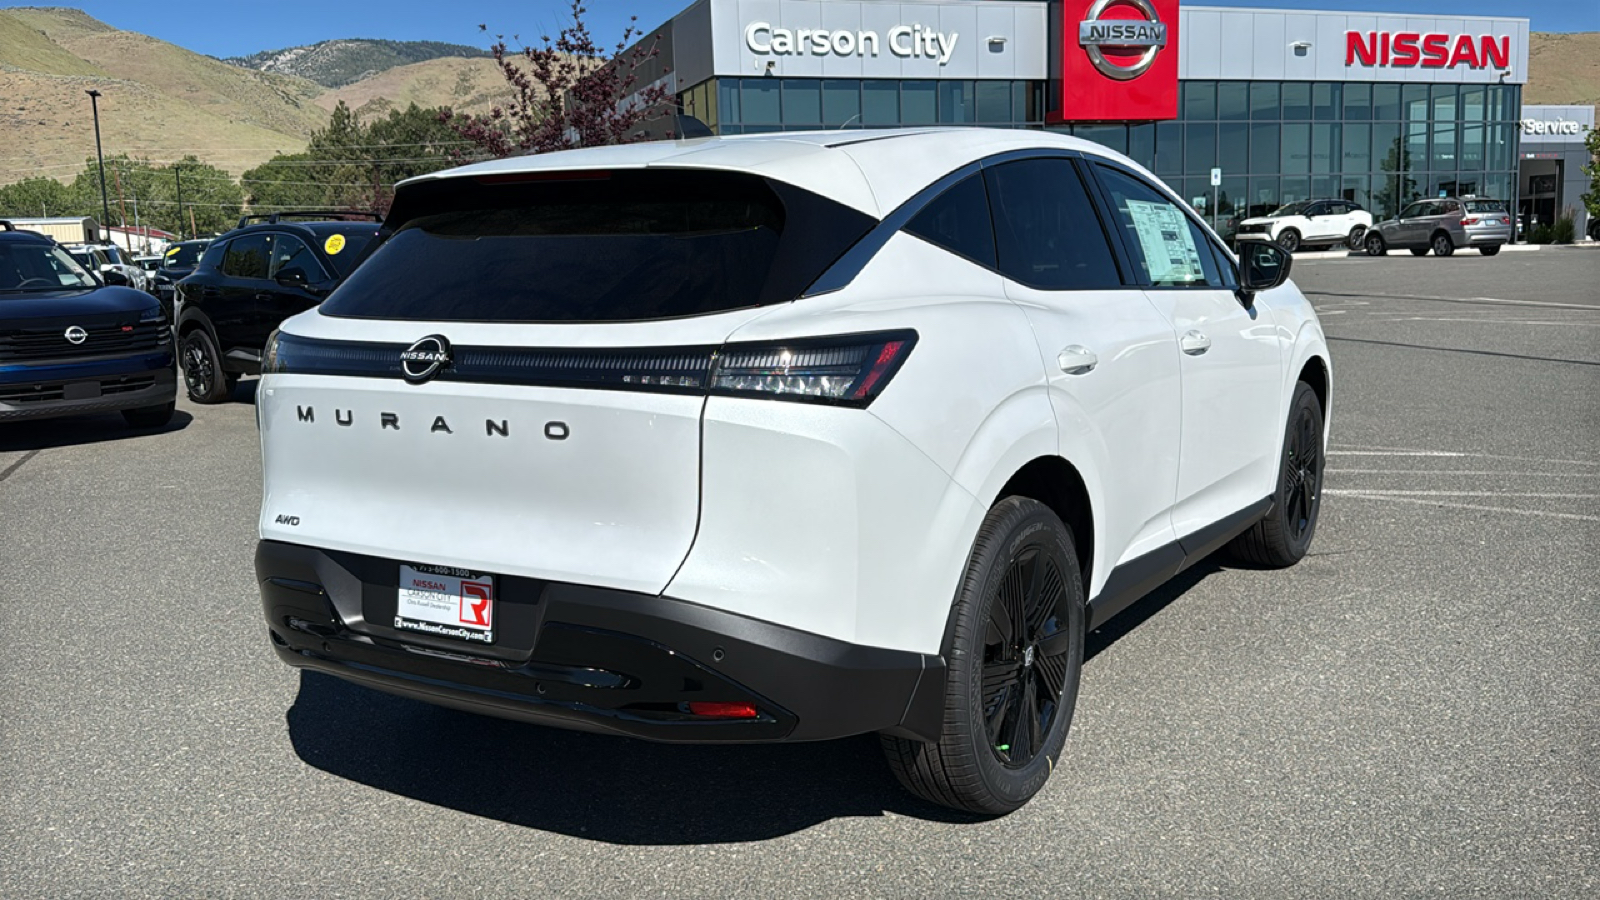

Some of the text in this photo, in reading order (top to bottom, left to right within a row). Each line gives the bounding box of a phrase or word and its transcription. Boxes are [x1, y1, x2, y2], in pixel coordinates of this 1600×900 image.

[1089, 25, 1163, 41] NISSAN
[745, 22, 959, 65] Carson City
[1345, 31, 1510, 69] NISSAN
[1524, 117, 1579, 134] Service
[400, 352, 445, 361] NISSAN
[297, 405, 571, 441] MURANO
[275, 513, 300, 526] AWD
[412, 579, 446, 591] NISSAN
